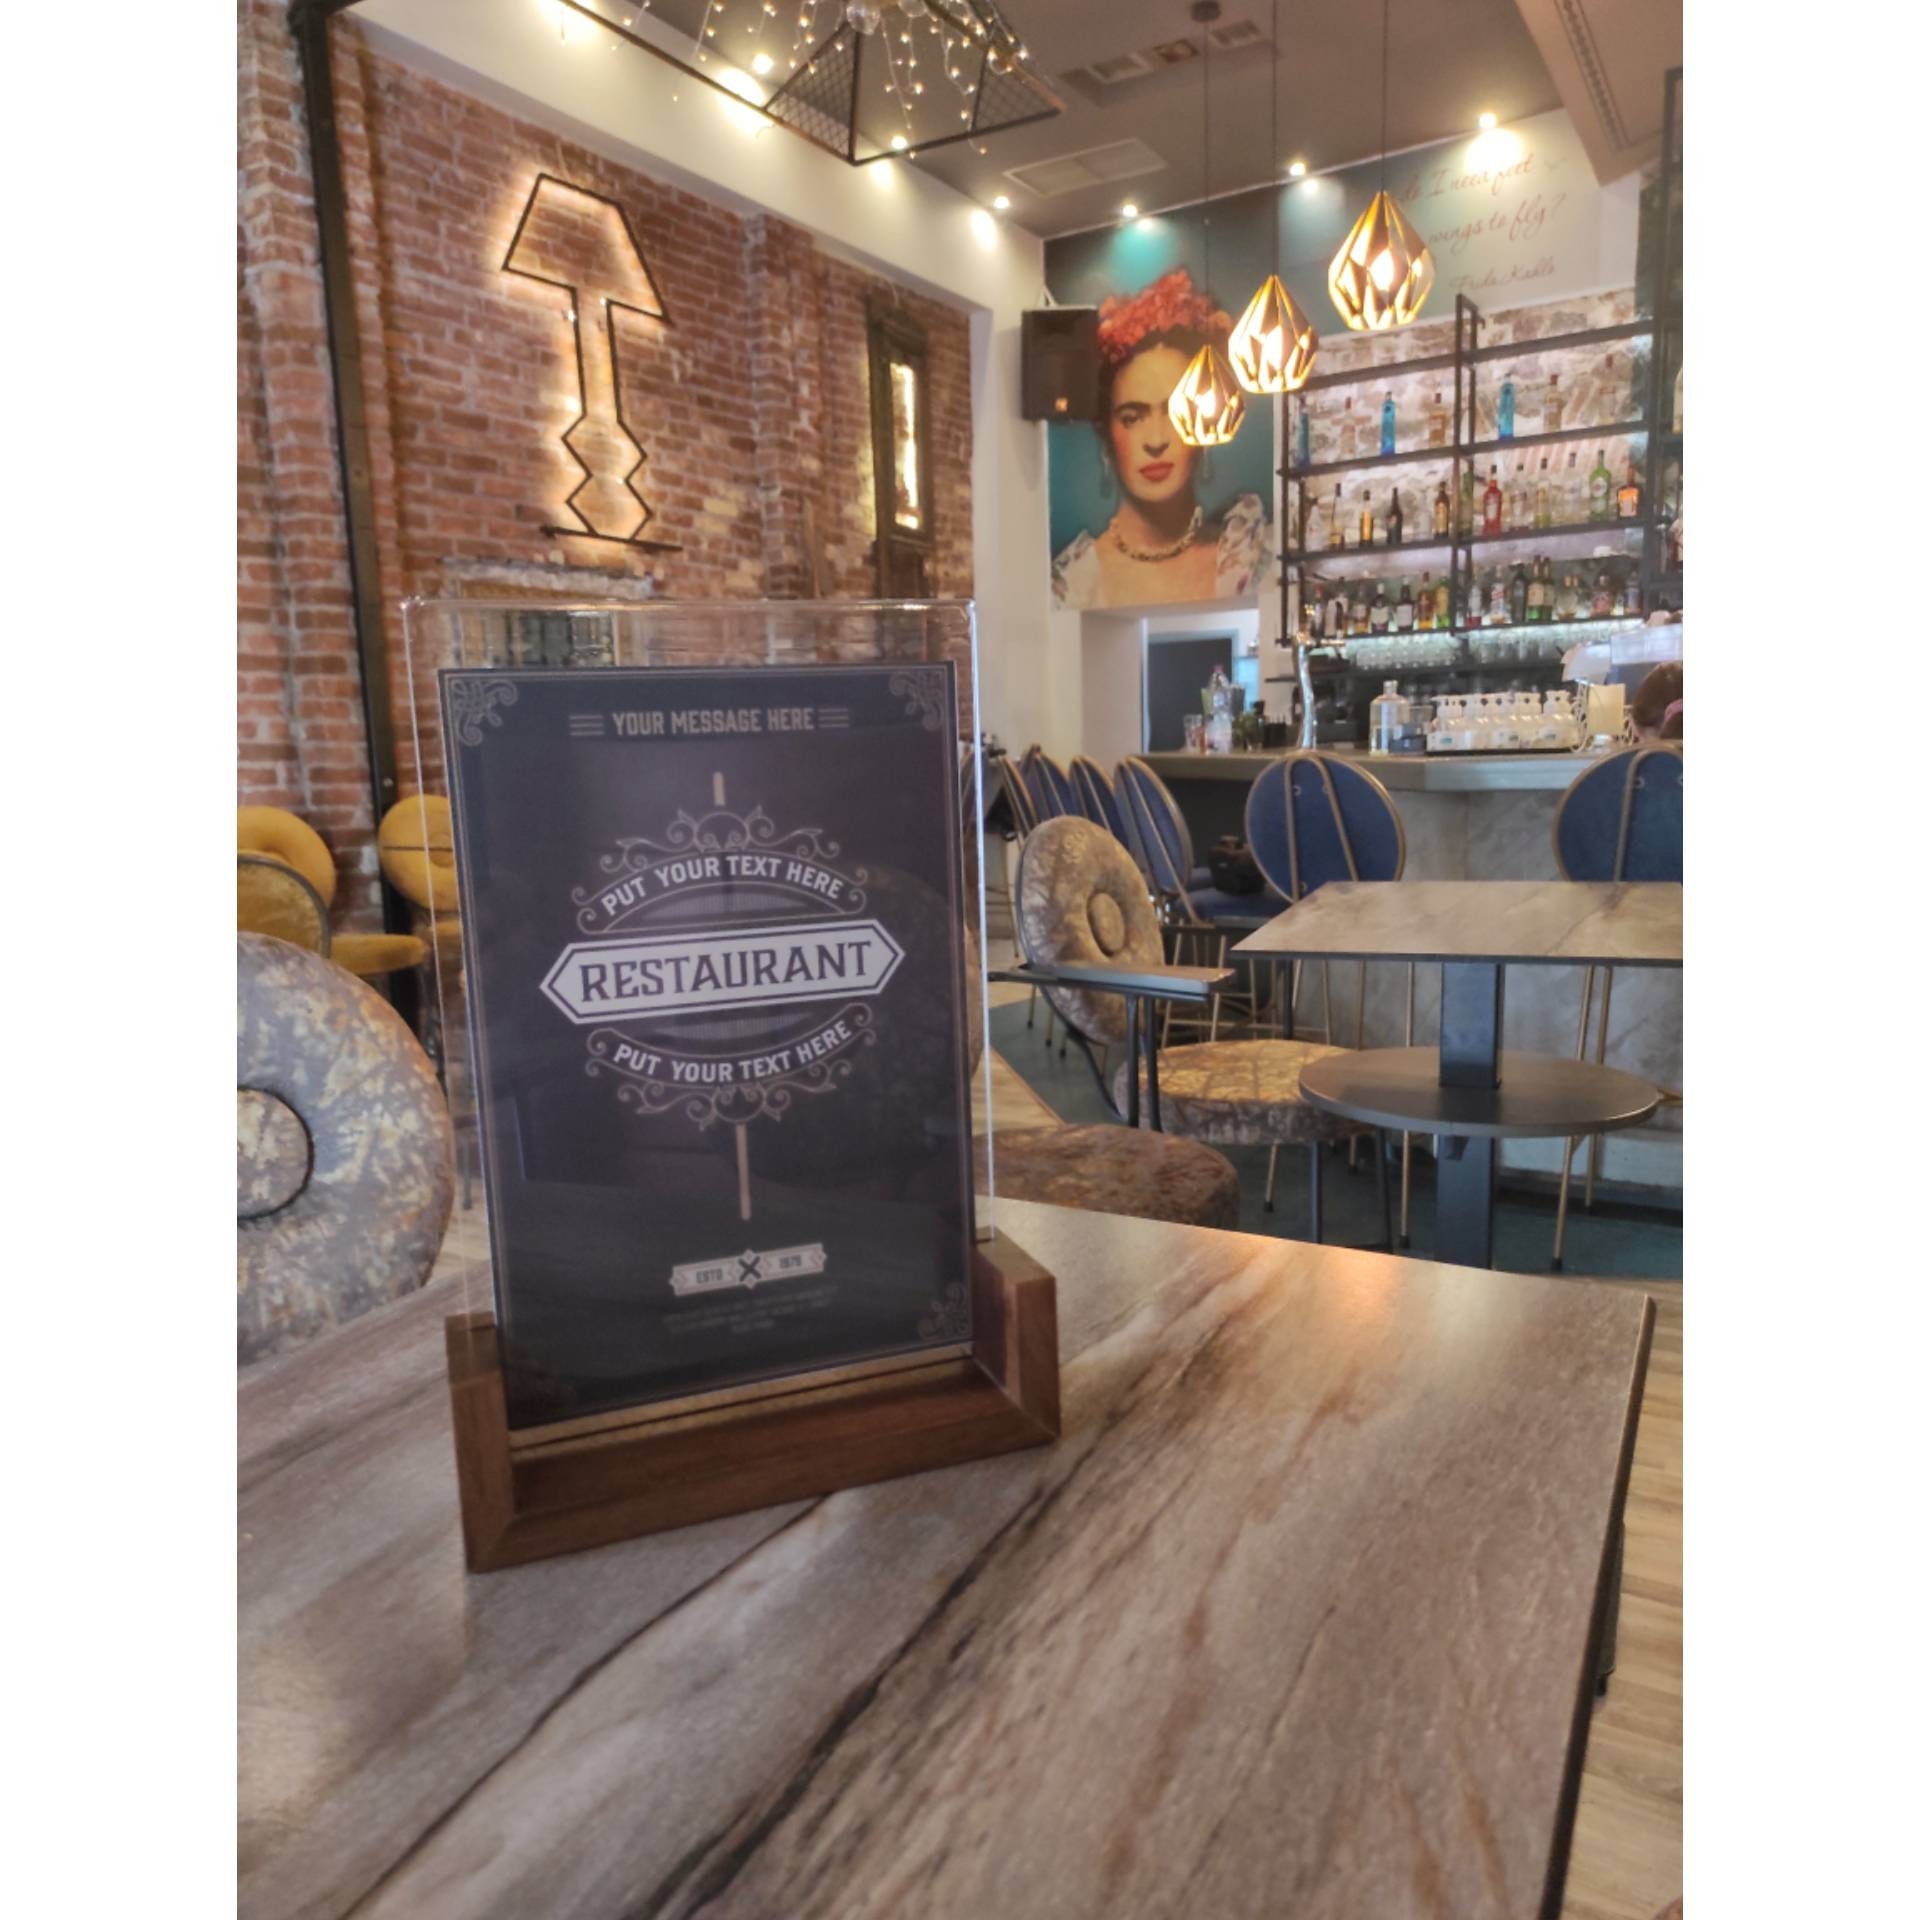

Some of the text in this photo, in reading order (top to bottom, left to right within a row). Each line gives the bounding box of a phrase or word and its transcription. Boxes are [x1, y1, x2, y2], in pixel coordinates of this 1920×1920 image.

[612, 708, 814, 736] YOUR MESSAGE HERE
[601, 855, 843, 916] PUT YOUR TEXT HERE
[579, 940, 872, 1002] RESTAURANT
[613, 1020, 852, 1083] PUT YOUR TEXT HERE
